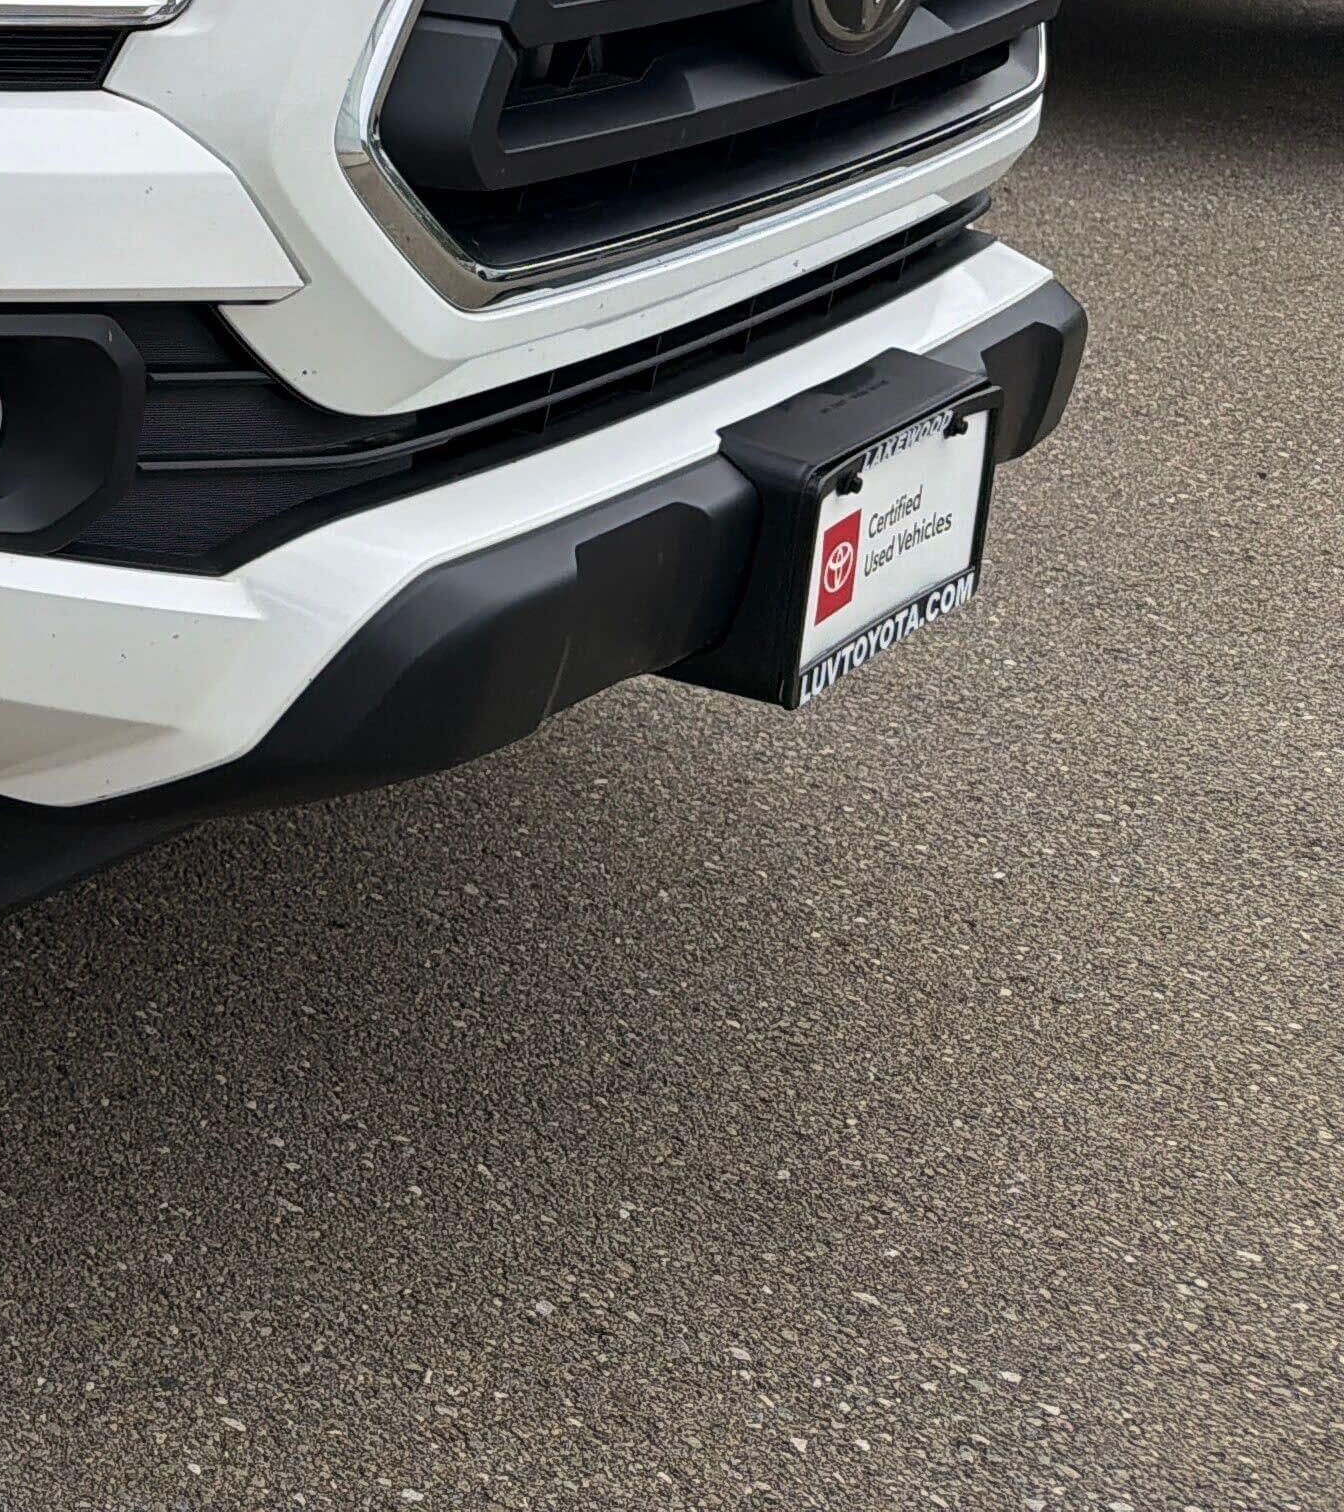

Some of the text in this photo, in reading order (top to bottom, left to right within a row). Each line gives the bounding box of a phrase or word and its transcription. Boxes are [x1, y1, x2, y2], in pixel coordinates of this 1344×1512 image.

[864, 511, 953, 578] Used Vehicles
[868, 483, 924, 540] Certified
[799, 572, 975, 707] LUVTOYOTA.COM
